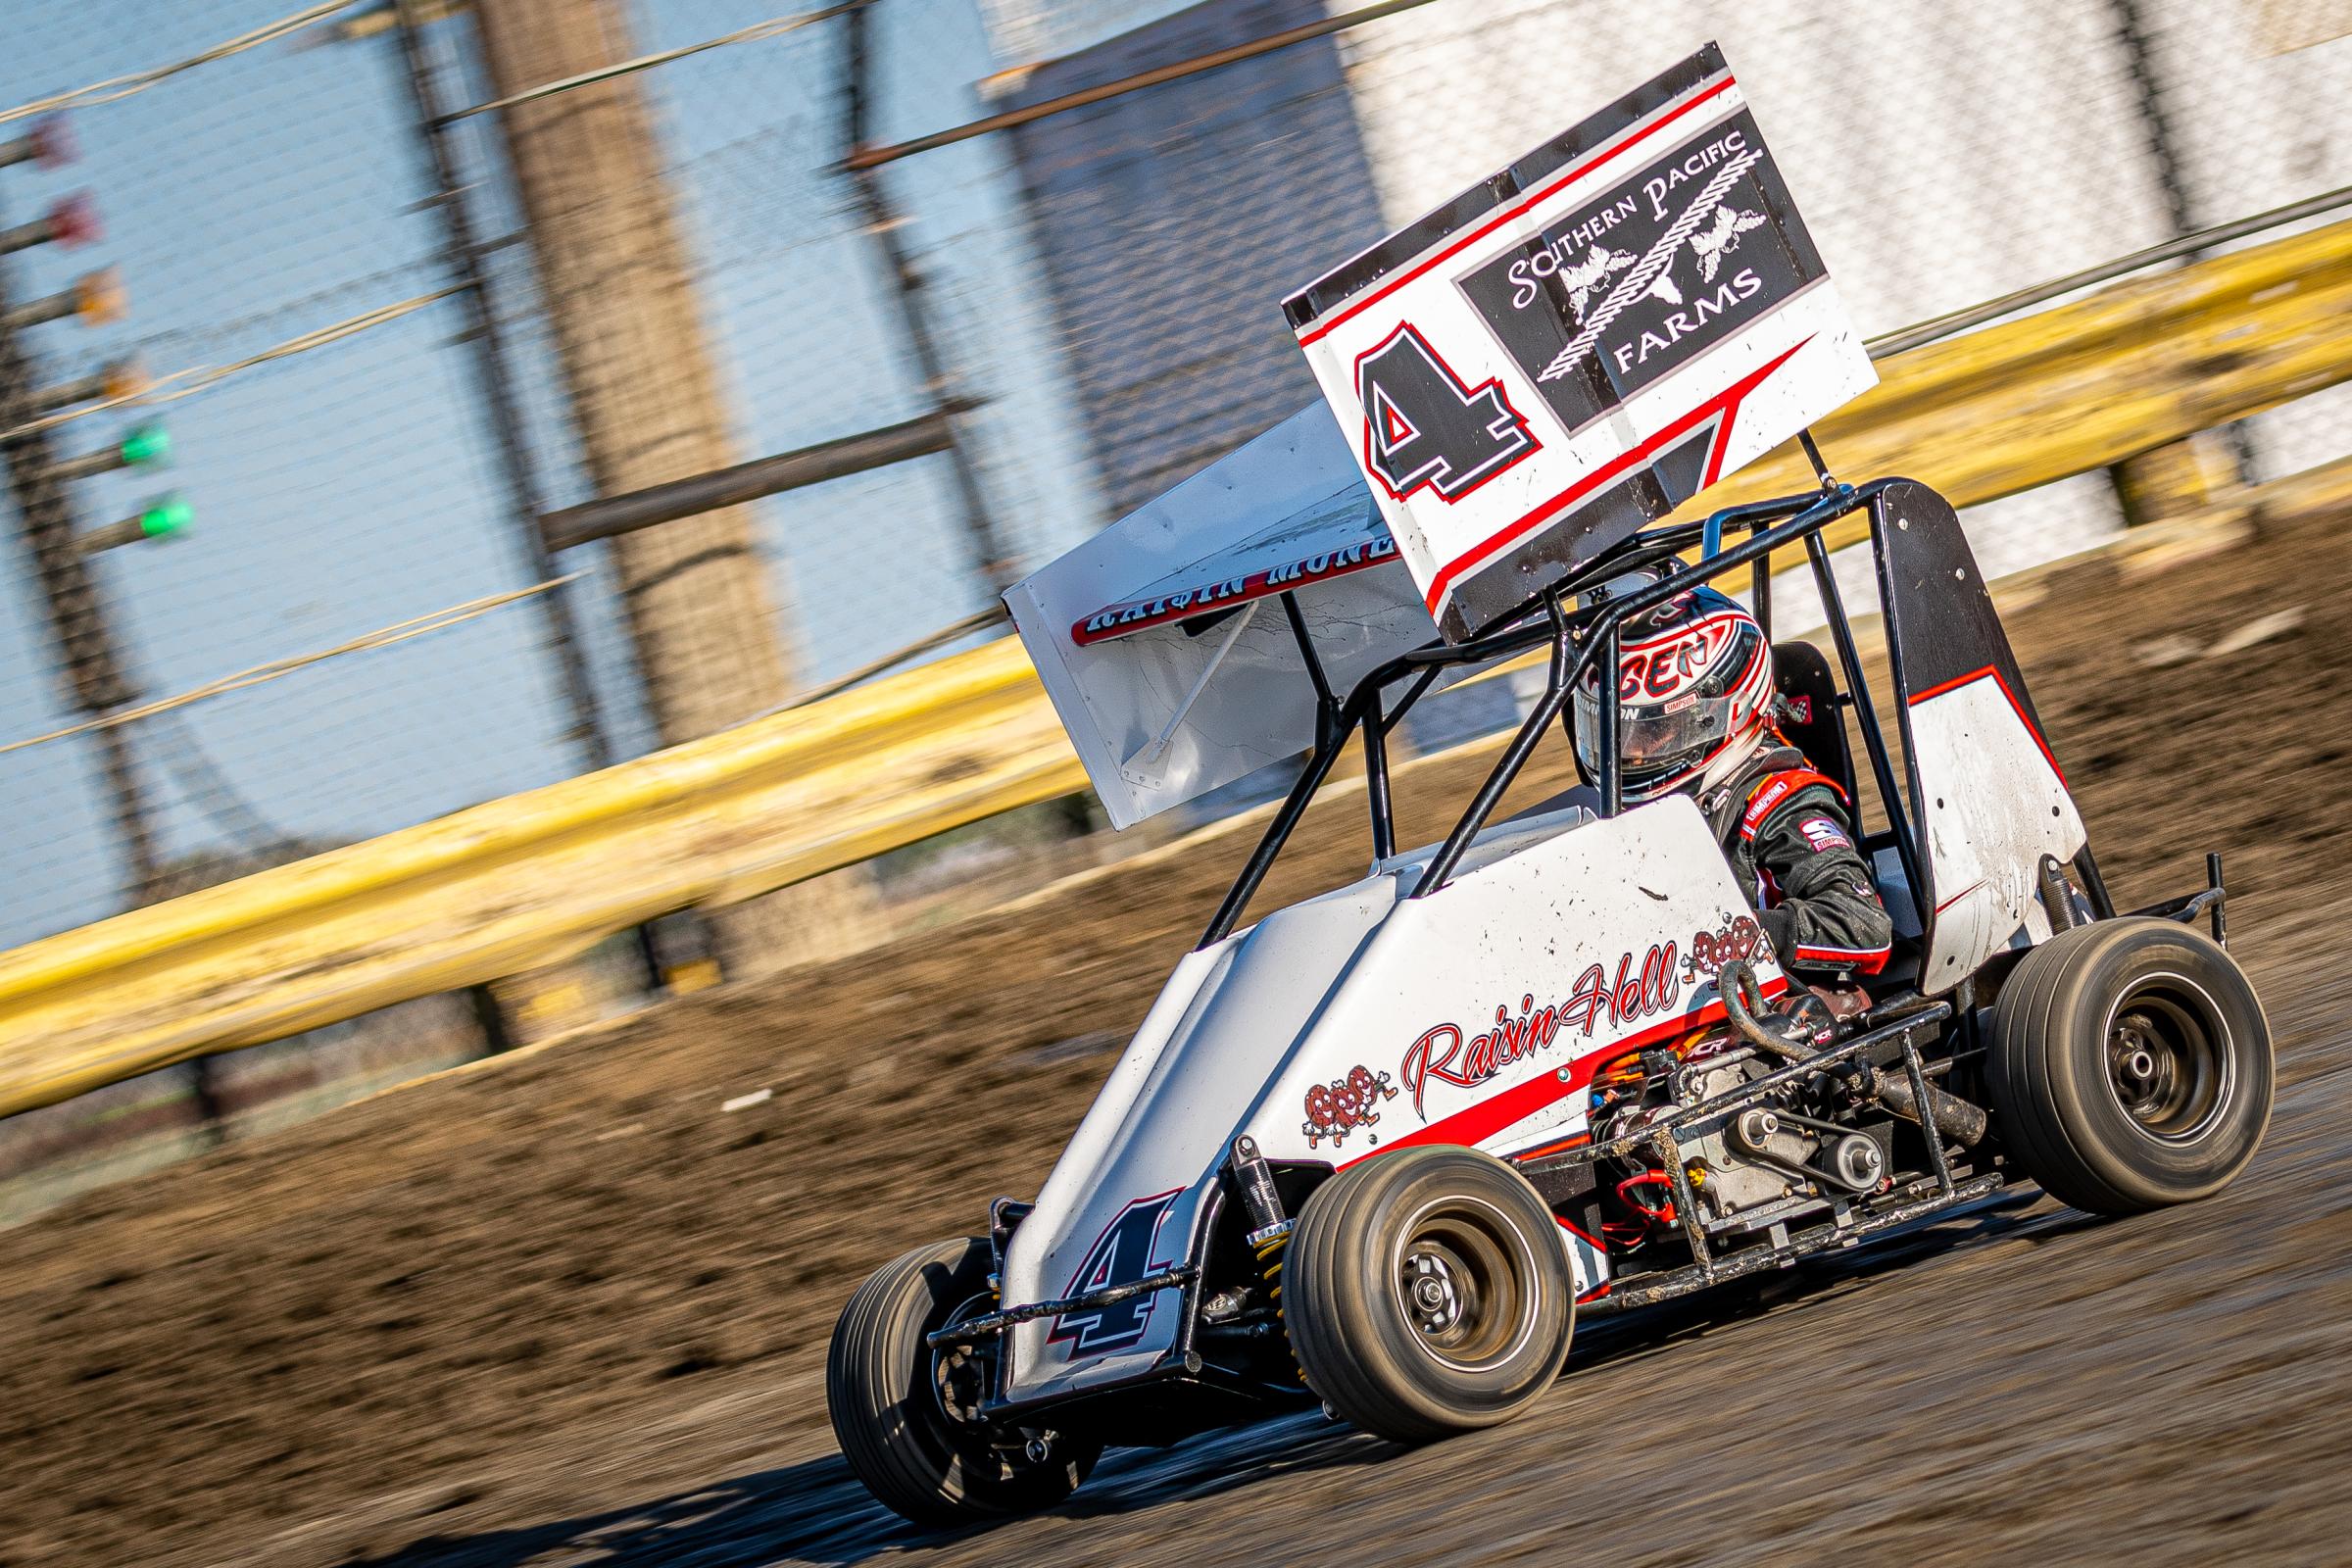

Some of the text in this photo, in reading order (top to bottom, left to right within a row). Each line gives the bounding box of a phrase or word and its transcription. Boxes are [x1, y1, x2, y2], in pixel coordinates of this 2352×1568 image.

[1642, 130, 1746, 222] PACIFIC
[1613, 268, 1762, 374] FARMS
[1354, 320, 1543, 504] 4
[1665, 694, 1695, 712] SIMPSON
[1401, 941, 1679, 1124] Raisin Hell
[1046, 1186, 1187, 1361] 4
